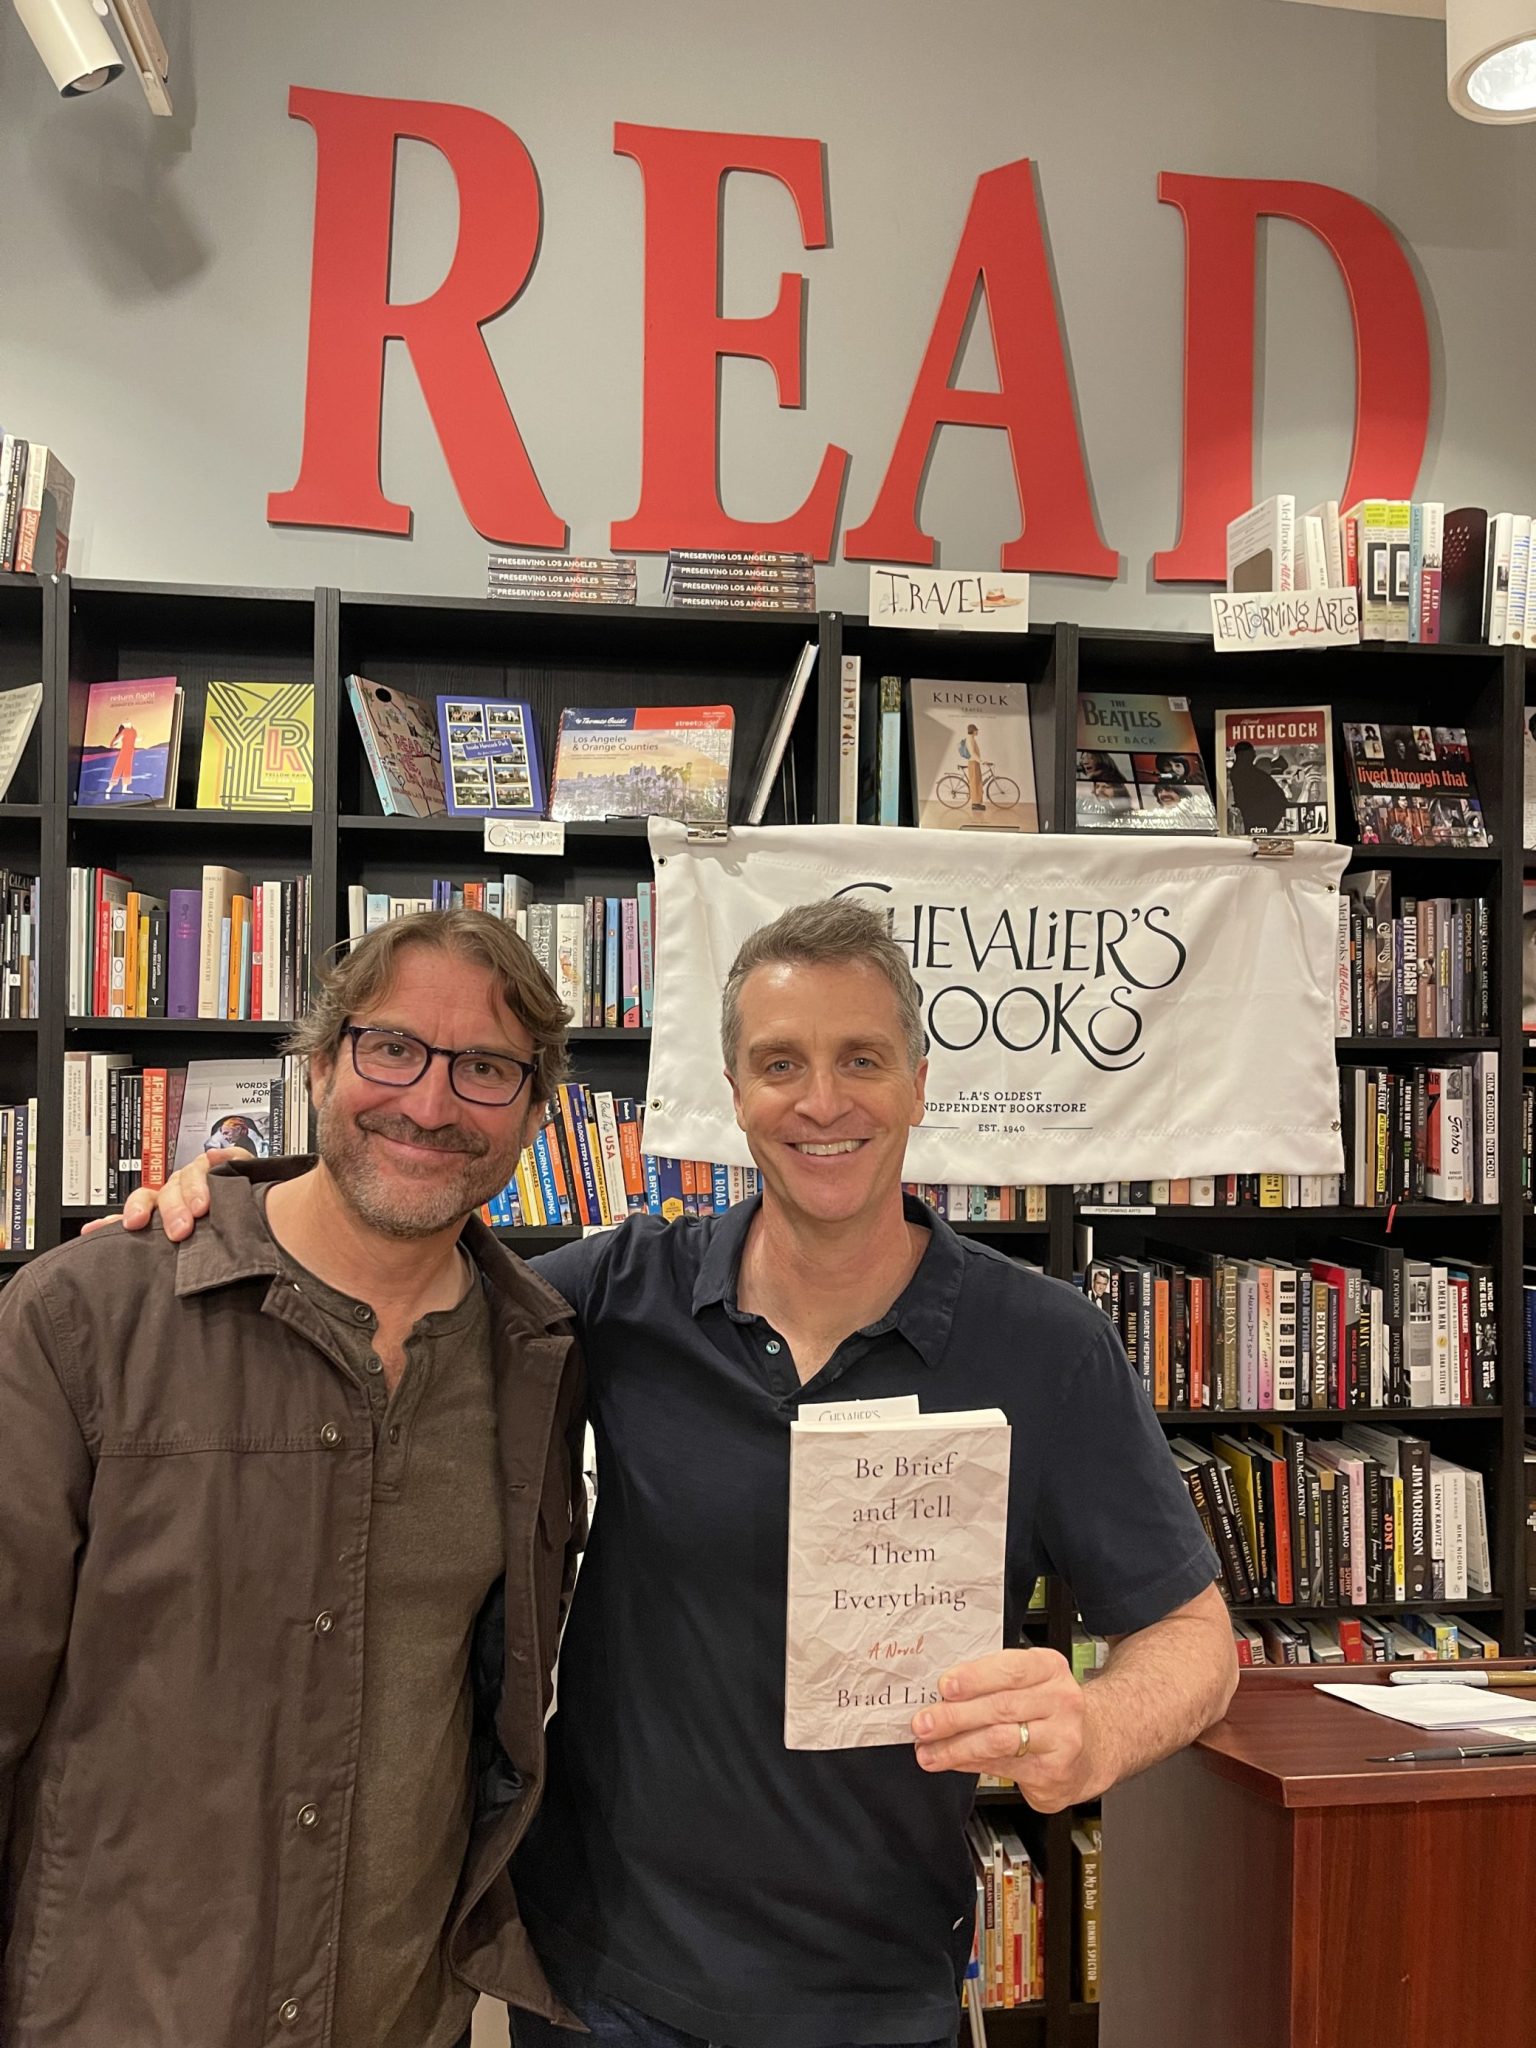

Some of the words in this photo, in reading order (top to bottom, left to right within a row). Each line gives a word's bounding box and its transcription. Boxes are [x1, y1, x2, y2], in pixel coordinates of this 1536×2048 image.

[267, 85, 1433, 583] READ
[498, 558, 546, 567] PRESERVING
[679, 552, 726, 560] PRESERVING
[499, 574, 547, 582] PRESERVING
[681, 567, 728, 575] PRESERVING
[497, 589, 545, 597] PRESERVING
[683, 583, 729, 591] PRESERVING
[876, 570, 996, 616] TRAVEL
[683, 598, 729, 606] PRESERVING
[1423, 575, 1431, 624] ZEPPELIN
[1431, 589, 1440, 610] LED
[110, 693, 134, 701] return
[135, 691, 155, 701] flight
[933, 692, 1009, 706] KINFOLK
[1110, 700, 1125, 708] THE
[1082, 700, 1162, 732] BEATLES
[590, 736, 627, 745] Angeles
[1097, 736, 1119, 744] GET
[1125, 737, 1157, 745] BACK
[1232, 723, 1318, 740] HITCHCOCK
[582, 743, 616, 752] Orange
[619, 743, 659, 751] Counties
[1357, 767, 1388, 783] lived
[1390, 768, 1440, 788] through
[1442, 771, 1468, 787] that
[1338, 902, 1348, 921] Mel
[1339, 923, 1349, 960] Brooks
[1403, 916, 1417, 960] CITIZEN
[1339, 964, 1348, 978] All
[1404, 962, 1417, 995] CASH
[1340, 981, 1349, 1001] About
[1340, 1003, 1351, 1021] Me!
[916, 982, 1145, 1071] OOKS
[1487, 1073, 1495, 1092] KIM
[152, 1076, 164, 1113] AFRICAN
[959, 1091, 990, 1101] L.A'S
[994, 1091, 1042, 1101] OLDEST
[1404, 1085, 1412, 1112] REMAIN
[924, 1103, 1006, 1113] NDEPENDENT
[1009, 1103, 1087, 1113] BOOKSTORE
[1404, 1113, 1411, 1121] IN
[1487, 1094, 1495, 1134] GORDON
[16, 1116, 24, 1136] POET
[151, 1114, 163, 1152] AMERICAN
[576, 1122, 585, 1142] 10,000
[978, 1124, 1000, 1132] EST.
[1004, 1125, 1026, 1133] 1940
[1448, 1115, 1462, 1155] Garbo
[580, 1143, 588, 1161] STEPS
[1487, 1139, 1495, 1153] NO
[151, 1154, 162, 1185] POETRY
[531, 1161, 539, 1188] ANGELES
[536, 1132, 549, 1177] ALIFORNIA
[544, 1178, 556, 1215] CAMPING
[595, 1156, 604, 1185] SOUTHERN
[1487, 1155, 1495, 1178] ICON
[14, 1188, 22, 1201] JOY
[599, 1186, 609, 1219] CALIFORNIA
[649, 1179, 659, 1206] BRYCE
[1225, 1275, 1235, 1303] THE
[1302, 1282, 1310, 1304] BAD
[1438, 1281, 1446, 1311] CAMERA
[1479, 1277, 1487, 1292] THE
[1316, 1288, 1325, 1310] ME
[1487, 1302, 1494, 1312] OF
[1128, 1312, 1136, 1344] PHANTOM
[1225, 1307, 1236, 1345] BOYS
[1302, 1307, 1310, 1352] MOTHER
[1316, 1311, 1325, 1355] ELTON
[1360, 1312, 1370, 1347] JANIS
[1438, 1313, 1446, 1330] MAN
[1128, 1347, 1136, 1363] LADY
[1315, 1355, 1326, 1395] JOHN
[1296, 1441, 1305, 1463] PAUL
[855, 1457, 884, 1479] Be
[895, 1452, 959, 1478] Brief
[1411, 1464, 1423, 1487] JIM
[1190, 1473, 1205, 1508] LEVON
[1297, 1464, 1306, 1517] McCARTNEY
[852, 1498, 896, 1523] and
[909, 1495, 951, 1519] Tell
[1222, 1516, 1232, 1540] IDIOTS
[1342, 1516, 1350, 1548] MILANO
[1383, 1513, 1393, 1551] JONI
[1412, 1489, 1424, 1556] MORRISON
[866, 1542, 936, 1565] Them
[833, 1584, 967, 1616] Everything
[868, 1640, 881, 1661] A
[884, 1636, 925, 1659] Novel
[837, 1686, 891, 1709] Brad
[1085, 1863, 1097, 1875] Be
[1084, 1876, 1097, 1888] My
[1084, 1889, 1097, 1910] Baby
[1086, 1920, 1097, 1948] RONNIE
[1086, 1949, 1097, 1981] SPECTOR
